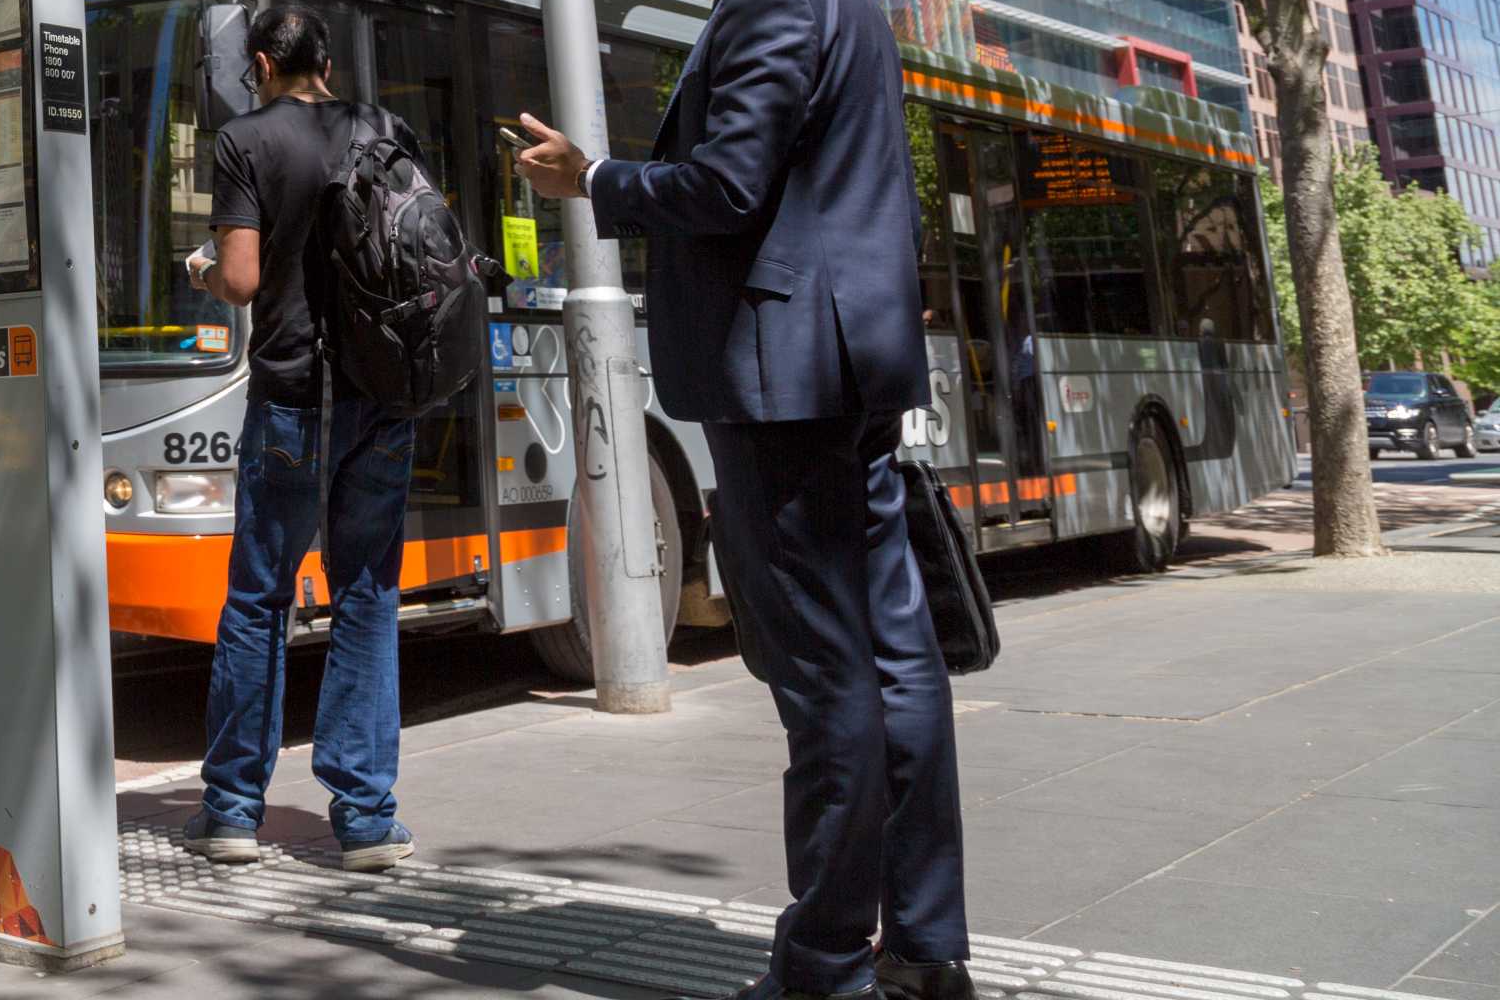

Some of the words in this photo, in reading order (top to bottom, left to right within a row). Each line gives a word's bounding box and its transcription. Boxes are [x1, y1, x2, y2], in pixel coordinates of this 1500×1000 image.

[43, 31, 81, 46] Timetable
[43, 43, 69, 56] Phone
[45, 56, 62, 67] 1800
[61, 69, 76, 80] 007
